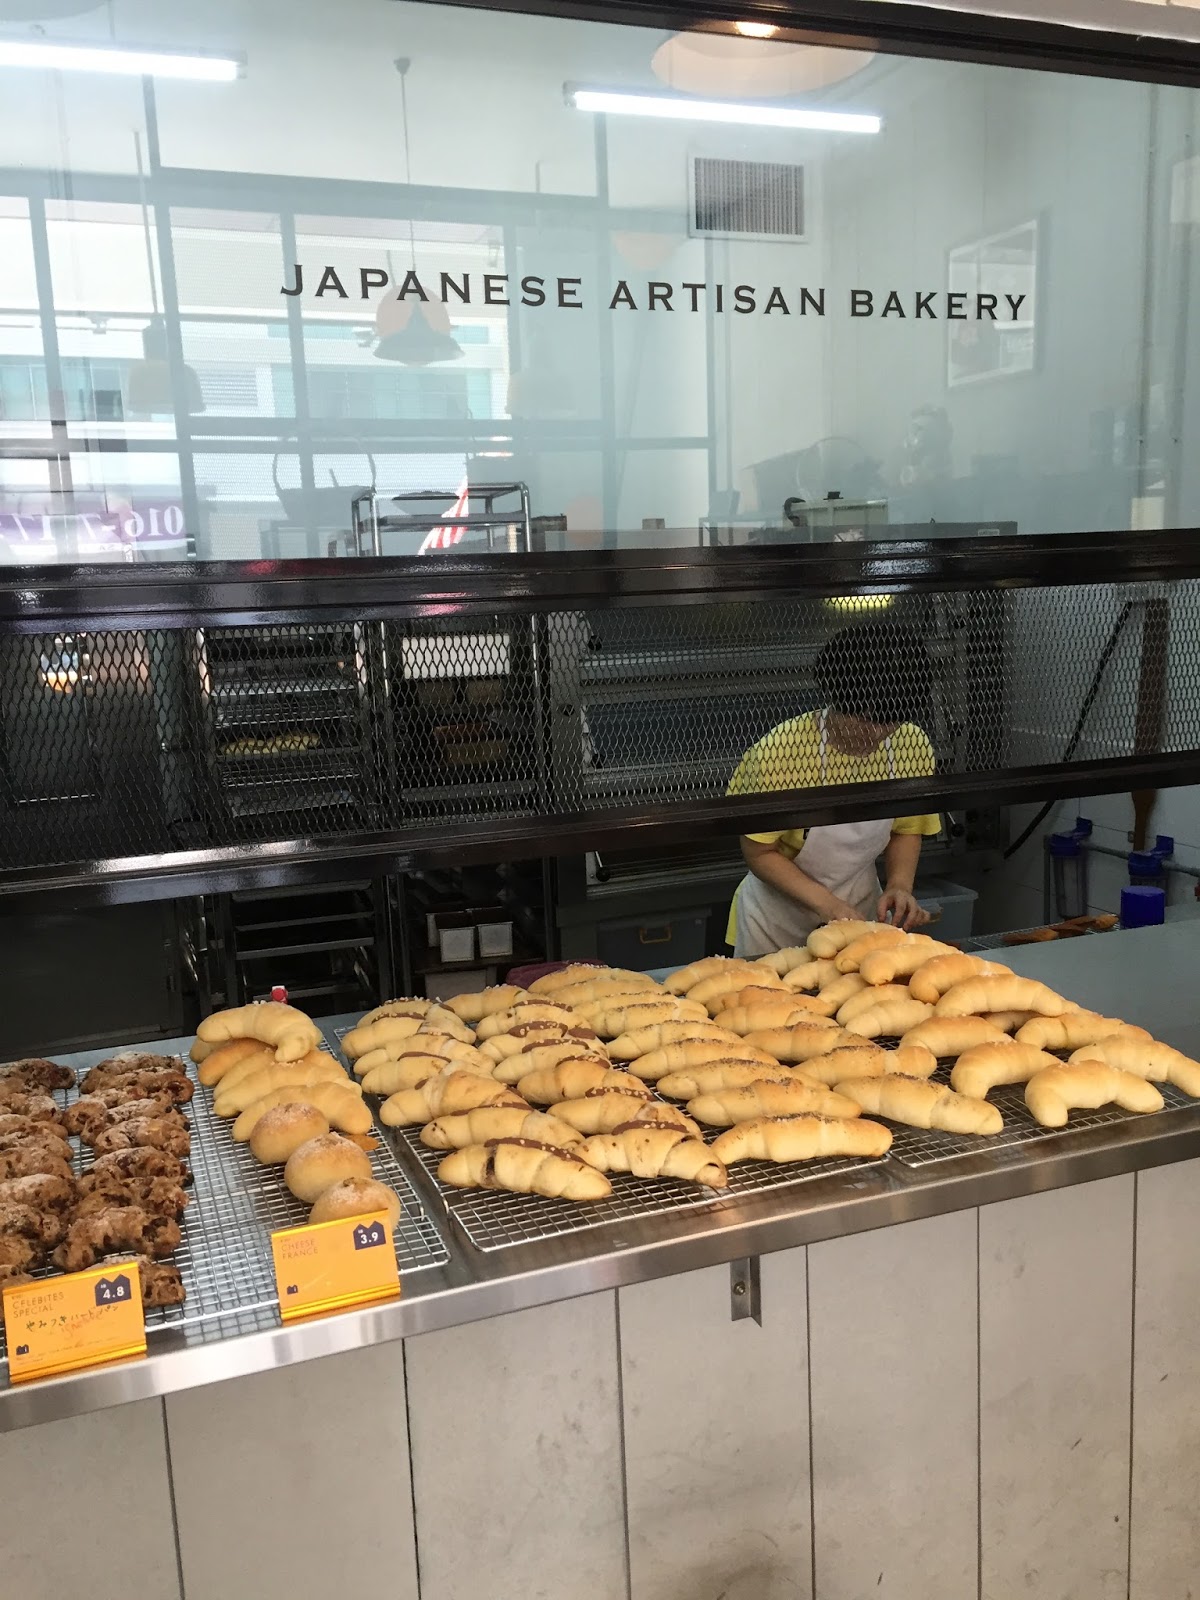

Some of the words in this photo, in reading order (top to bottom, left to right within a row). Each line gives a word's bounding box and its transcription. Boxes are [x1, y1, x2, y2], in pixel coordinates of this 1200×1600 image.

[281, 263, 583, 309] JAPANESE
[608, 280, 826, 316] ARTISAN
[850, 289, 1027, 321] BAKERY
[360, 1231, 379, 1245] 3.9
[281, 1239, 315, 1252] CHEESE
[282, 1247, 319, 1260] FRANCE
[102, 1286, 125, 1299] 4.8
[13, 1304, 54, 1319] SPECIAL
